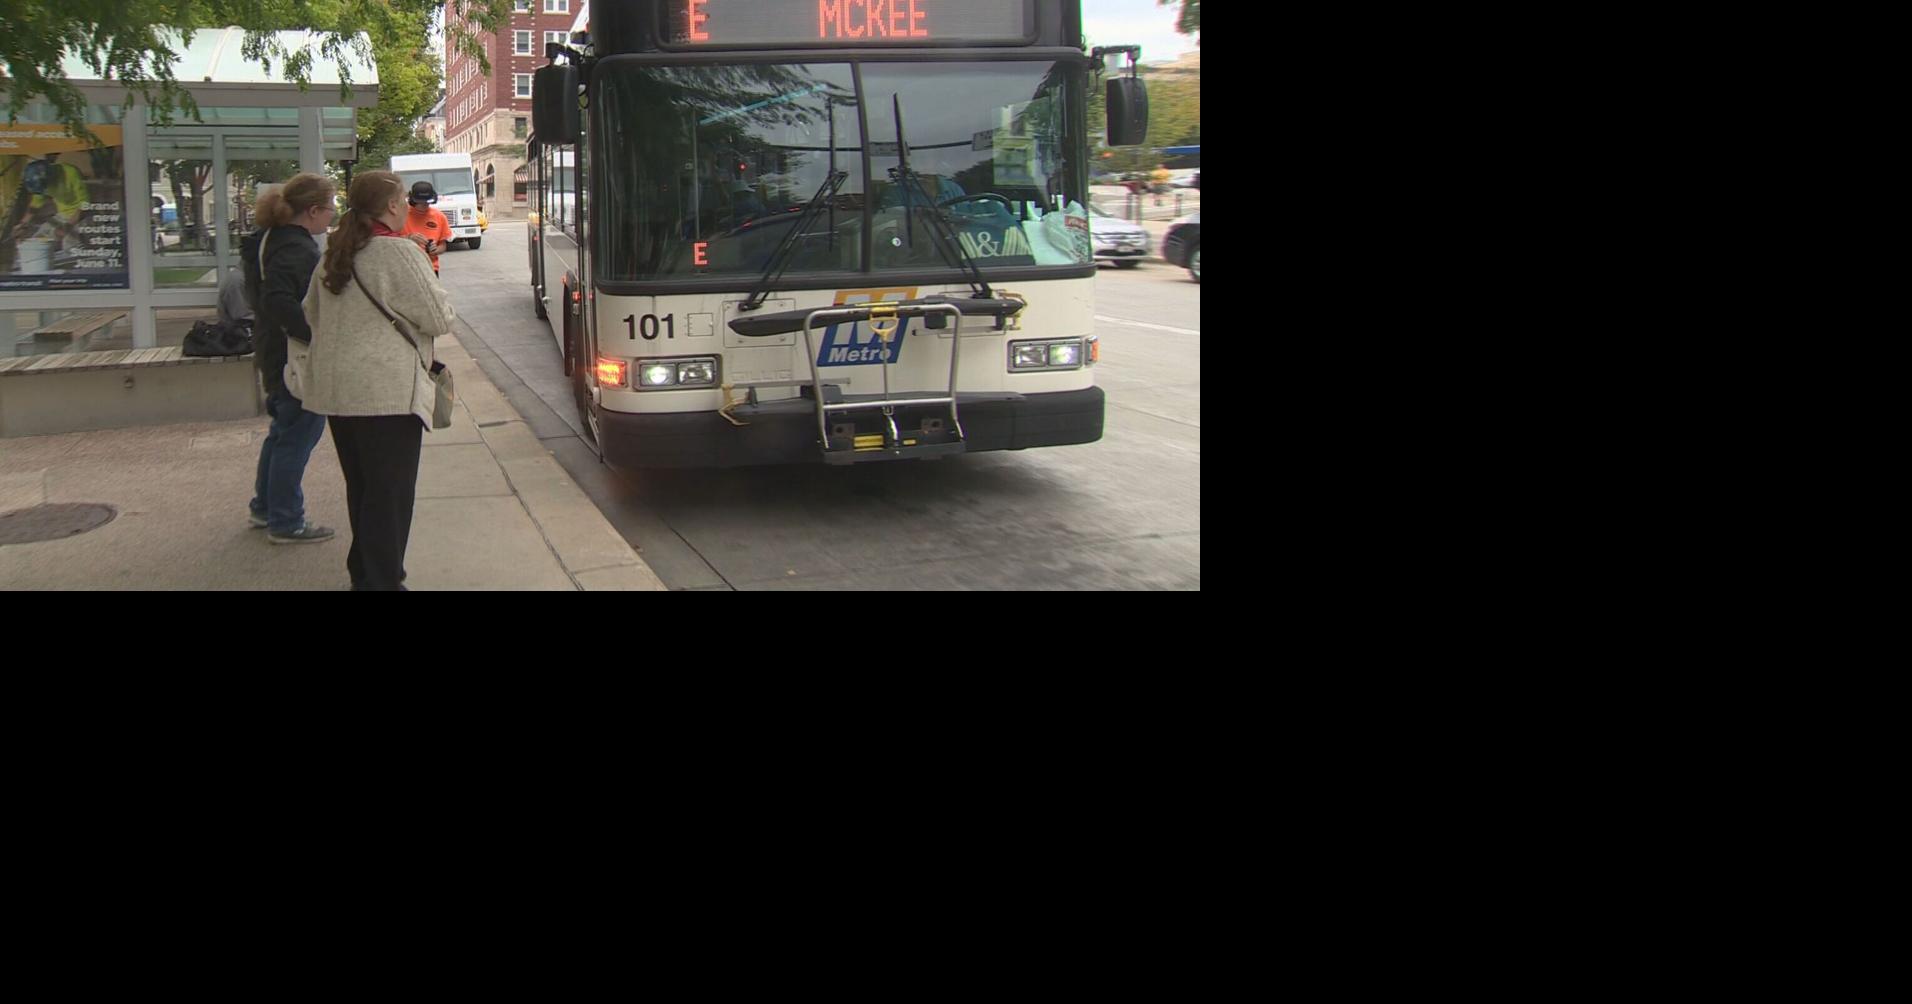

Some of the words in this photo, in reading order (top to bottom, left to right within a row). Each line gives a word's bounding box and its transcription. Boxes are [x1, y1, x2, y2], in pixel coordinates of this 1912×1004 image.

[689, 0, 709, 40] E
[819, 0, 928, 38] MCKEE
[80, 201, 120, 211] Brand
[92, 214, 120, 222] new
[78, 224, 121, 234] routes
[89, 236, 121, 245] start
[70, 247, 122, 258] Sunday,
[694, 242, 708, 265] E
[73, 259, 105, 268] June
[107, 258, 122, 268] 11.
[623, 313, 674, 341] 101
[828, 346, 892, 364] Metro
